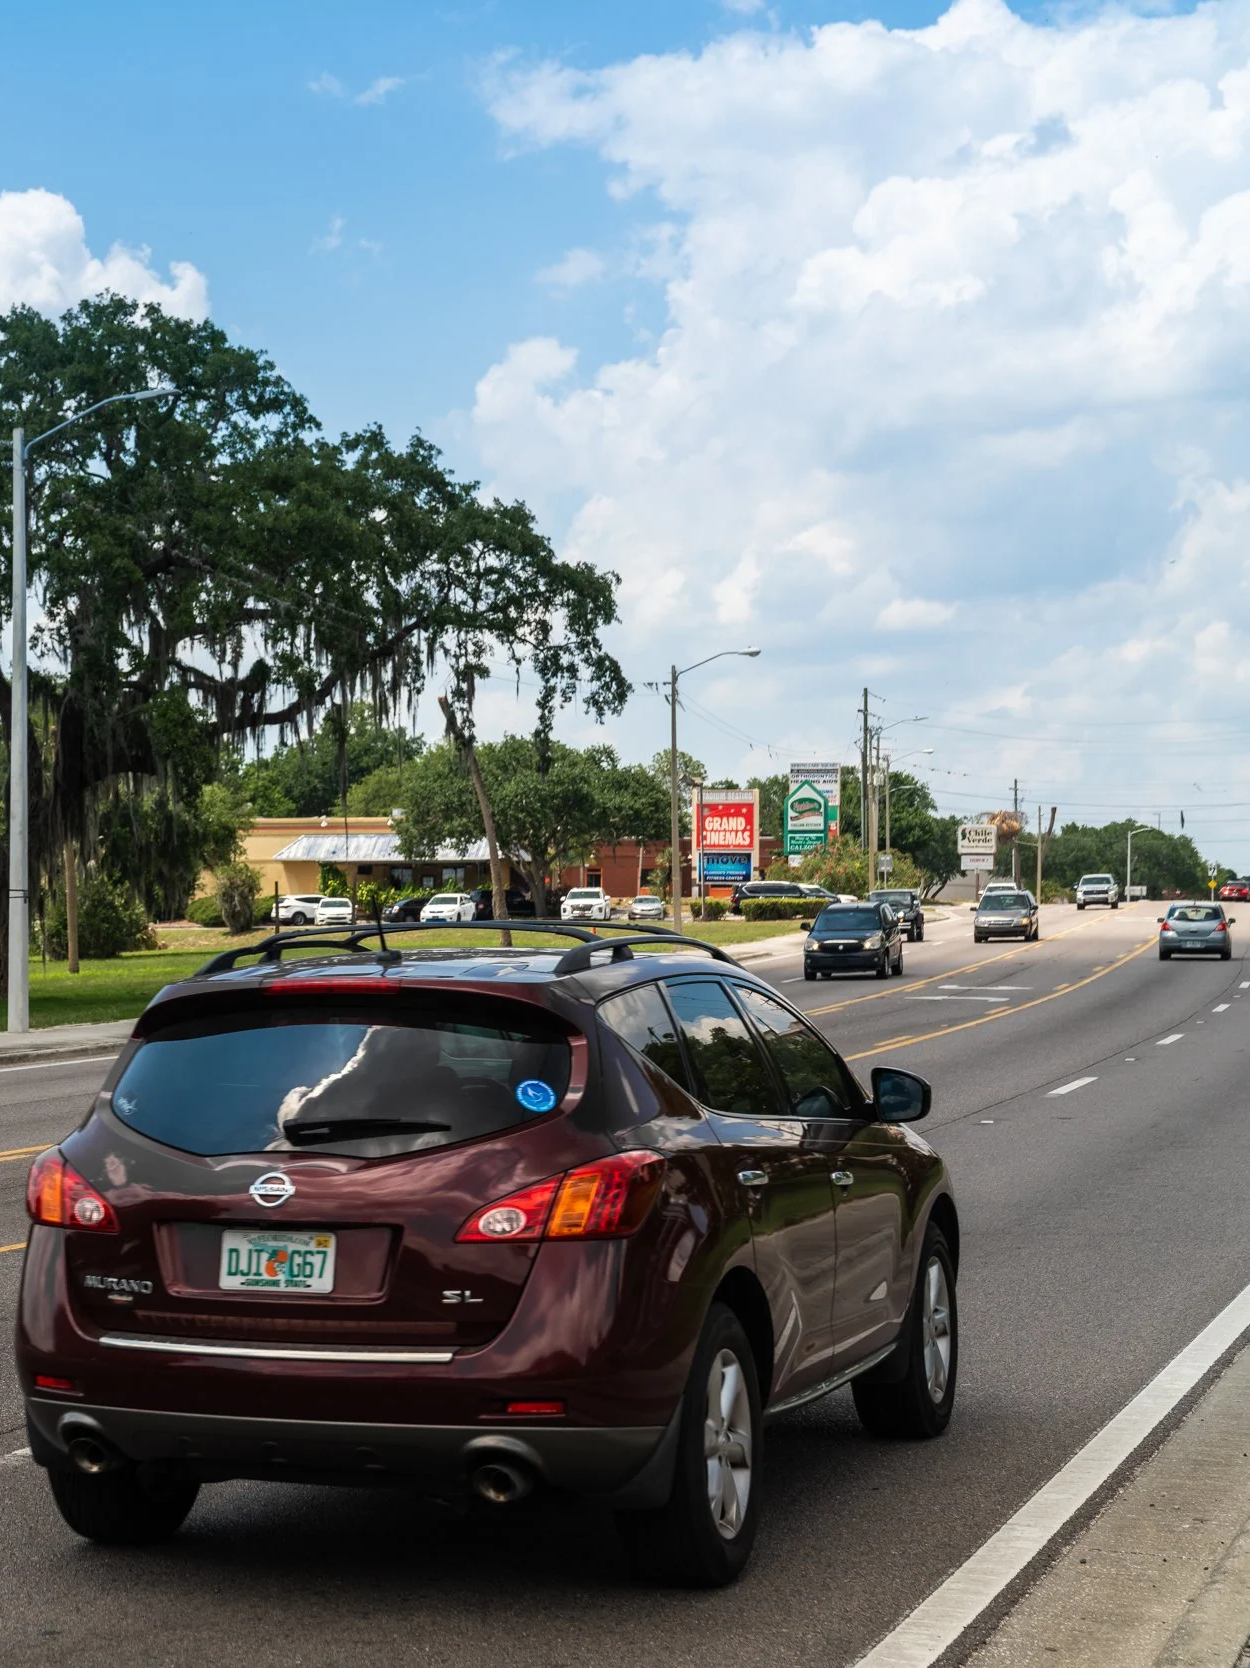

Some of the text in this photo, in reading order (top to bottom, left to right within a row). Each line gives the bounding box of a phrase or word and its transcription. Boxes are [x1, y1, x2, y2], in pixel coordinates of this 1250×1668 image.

[705, 816, 746, 831] GRAND
[700, 830, 750, 845] CINEMAS
[84, 1275, 153, 1294] MURANO
[442, 1290, 484, 1304] SL
